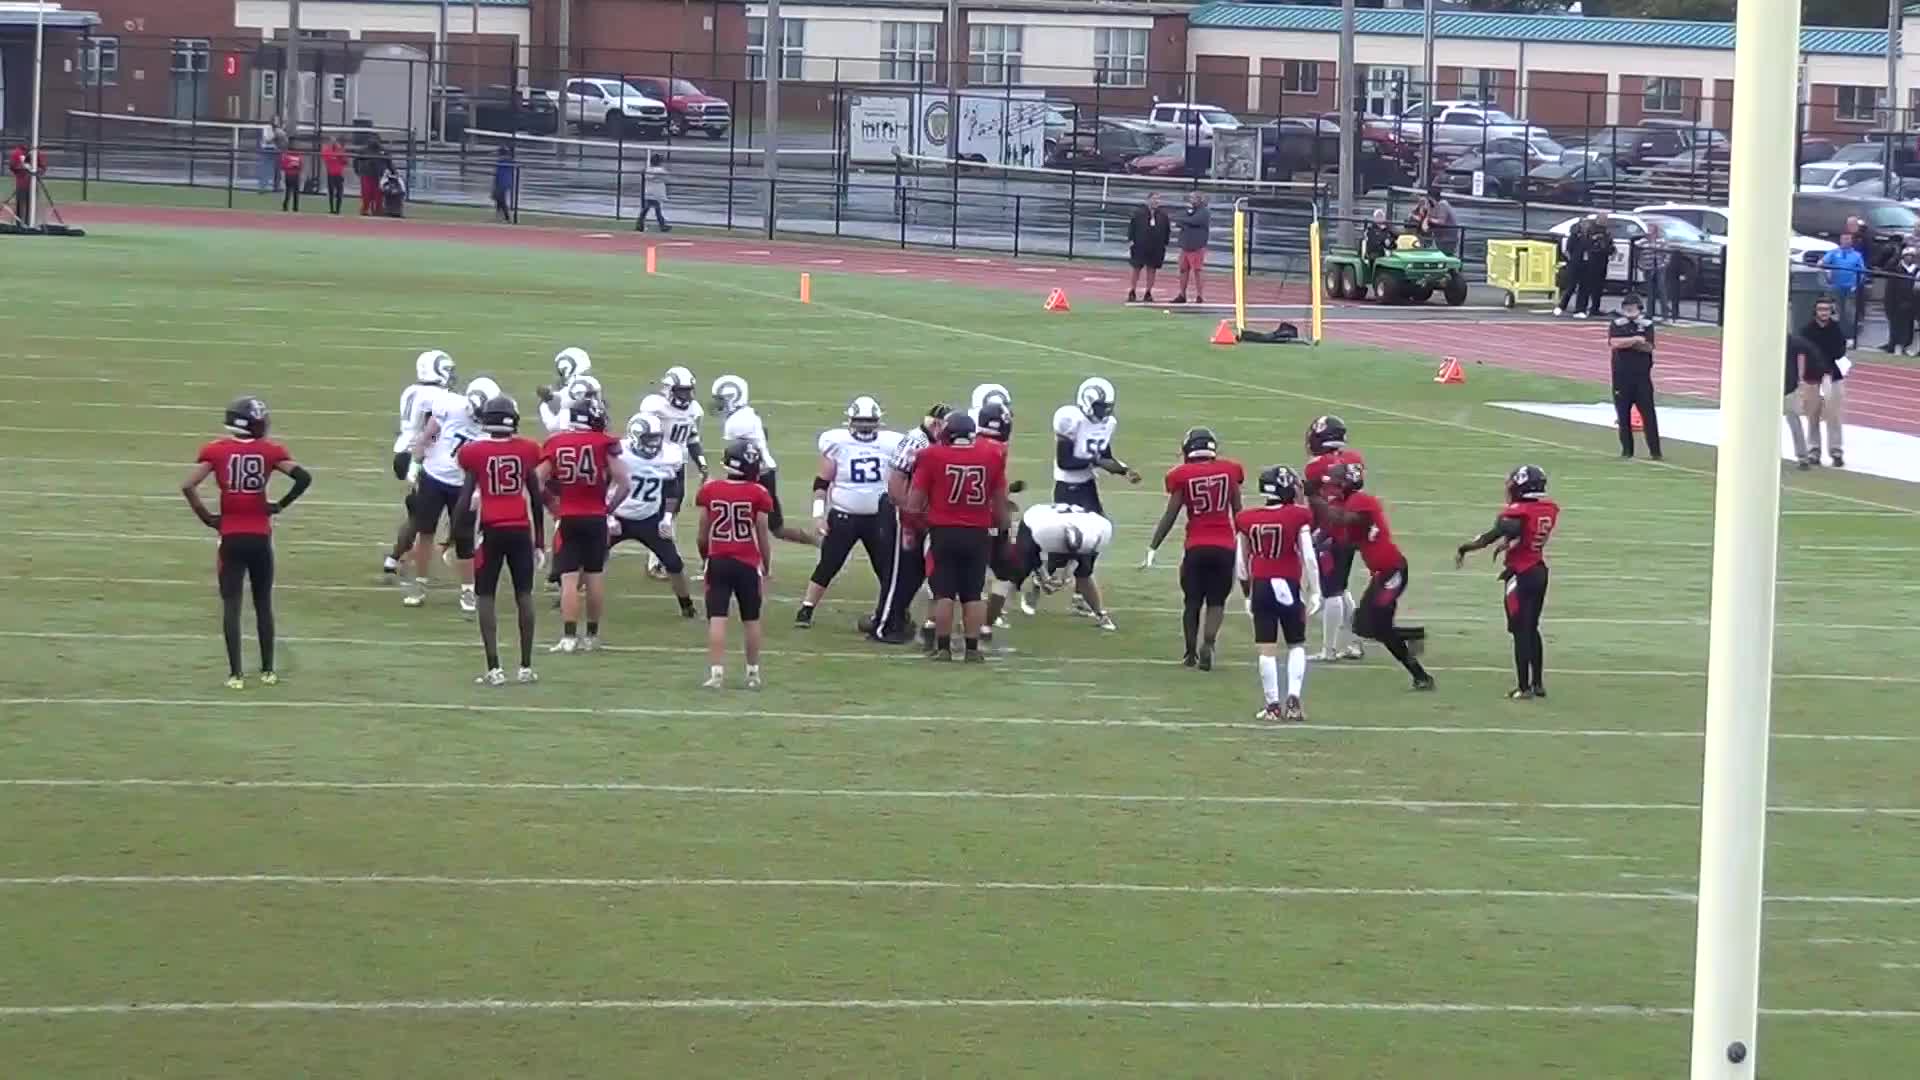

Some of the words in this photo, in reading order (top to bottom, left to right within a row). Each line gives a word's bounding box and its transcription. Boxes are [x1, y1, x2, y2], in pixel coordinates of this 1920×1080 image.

[228, 453, 265, 493] 18
[486, 455, 522, 495] 13
[556, 445, 597, 485] 54
[850, 457, 881, 483] 63
[945, 464, 986, 504] 73
[631, 475, 660, 502] 72
[1189, 473, 1229, 514] 57
[711, 500, 753, 542] 26
[1249, 524, 1283, 558] 17
